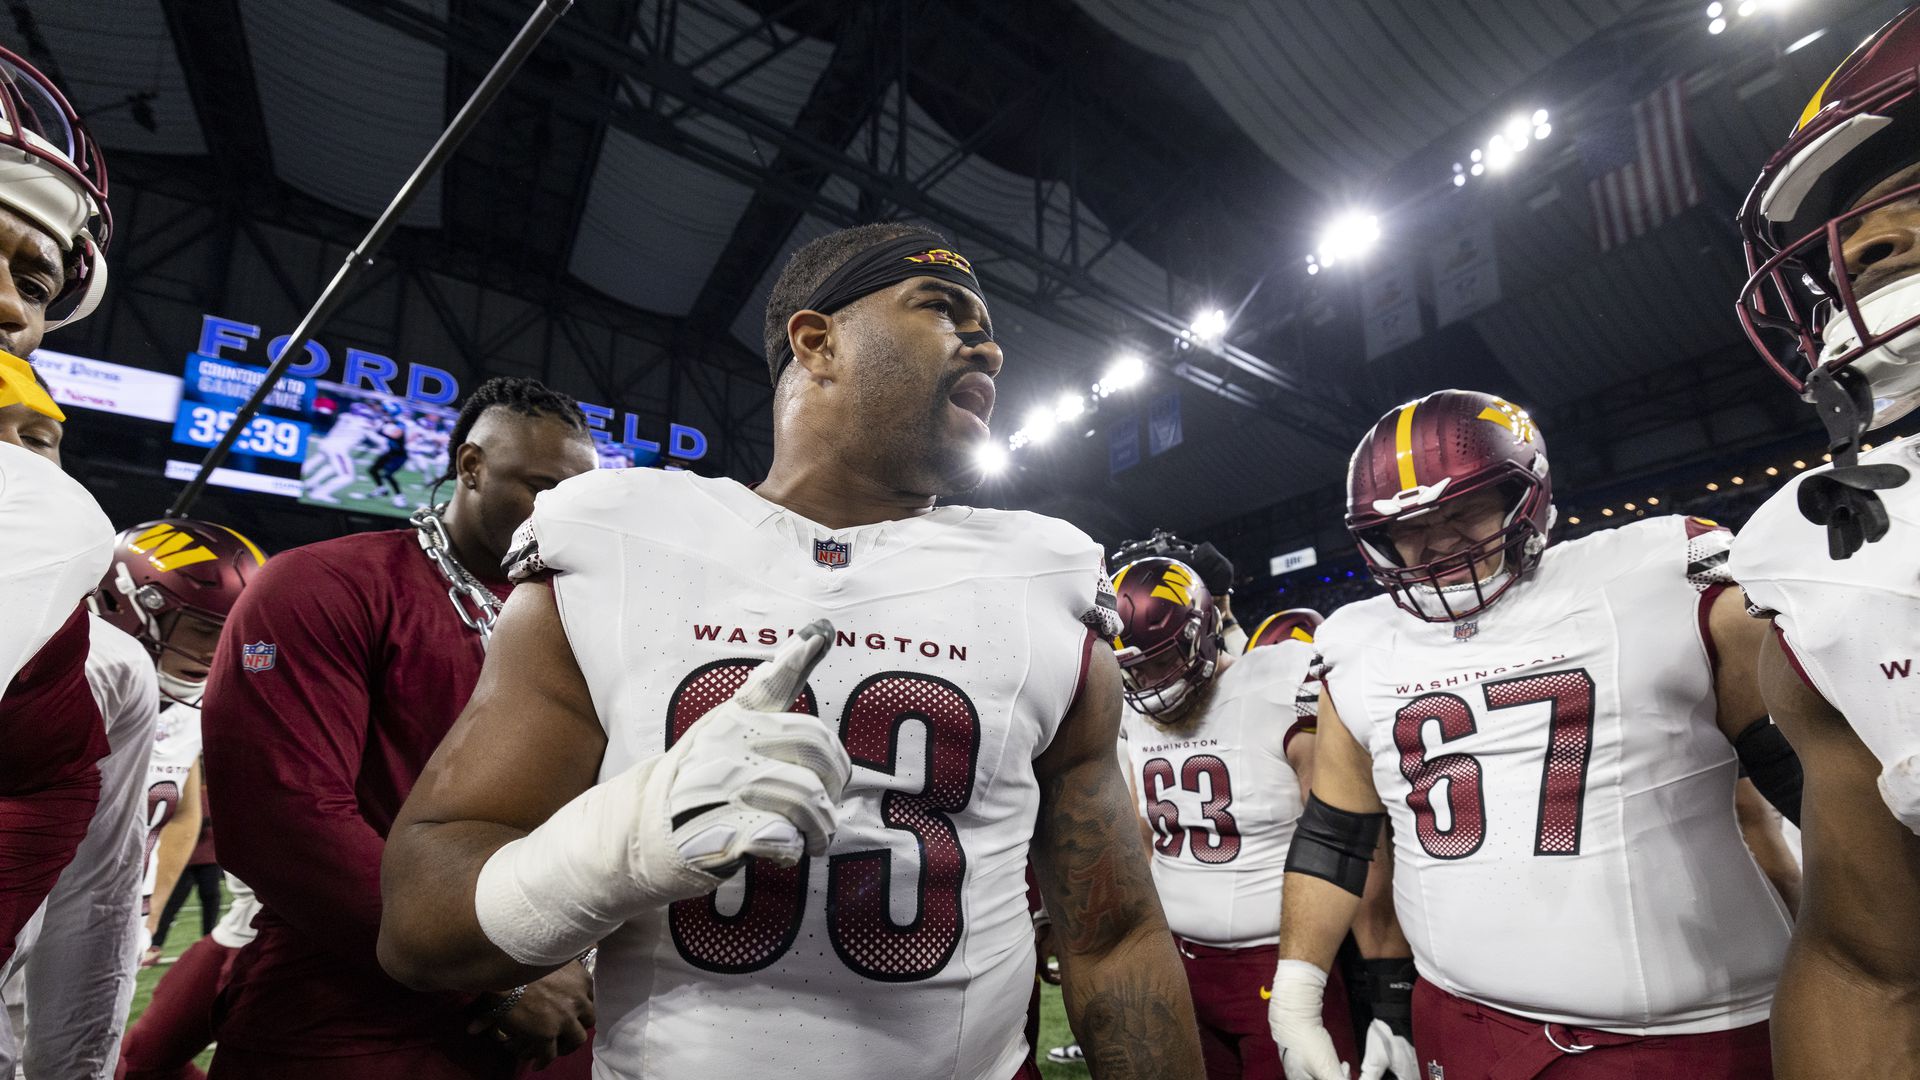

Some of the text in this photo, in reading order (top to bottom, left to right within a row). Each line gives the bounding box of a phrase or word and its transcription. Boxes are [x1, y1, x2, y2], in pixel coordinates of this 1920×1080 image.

[197, 314, 708, 461] FORD ELD
[199, 360, 285, 393] COUNTDN
[188, 406, 300, 457] 35:39
[818, 550, 845, 564] NFL
[244, 654, 272, 668] NFL
[693, 624, 967, 661] WASNGTON
[1142, 739, 1218, 753] WASHINGTON
[1393, 667, 1596, 861] 67
[1143, 753, 1242, 864] 63
